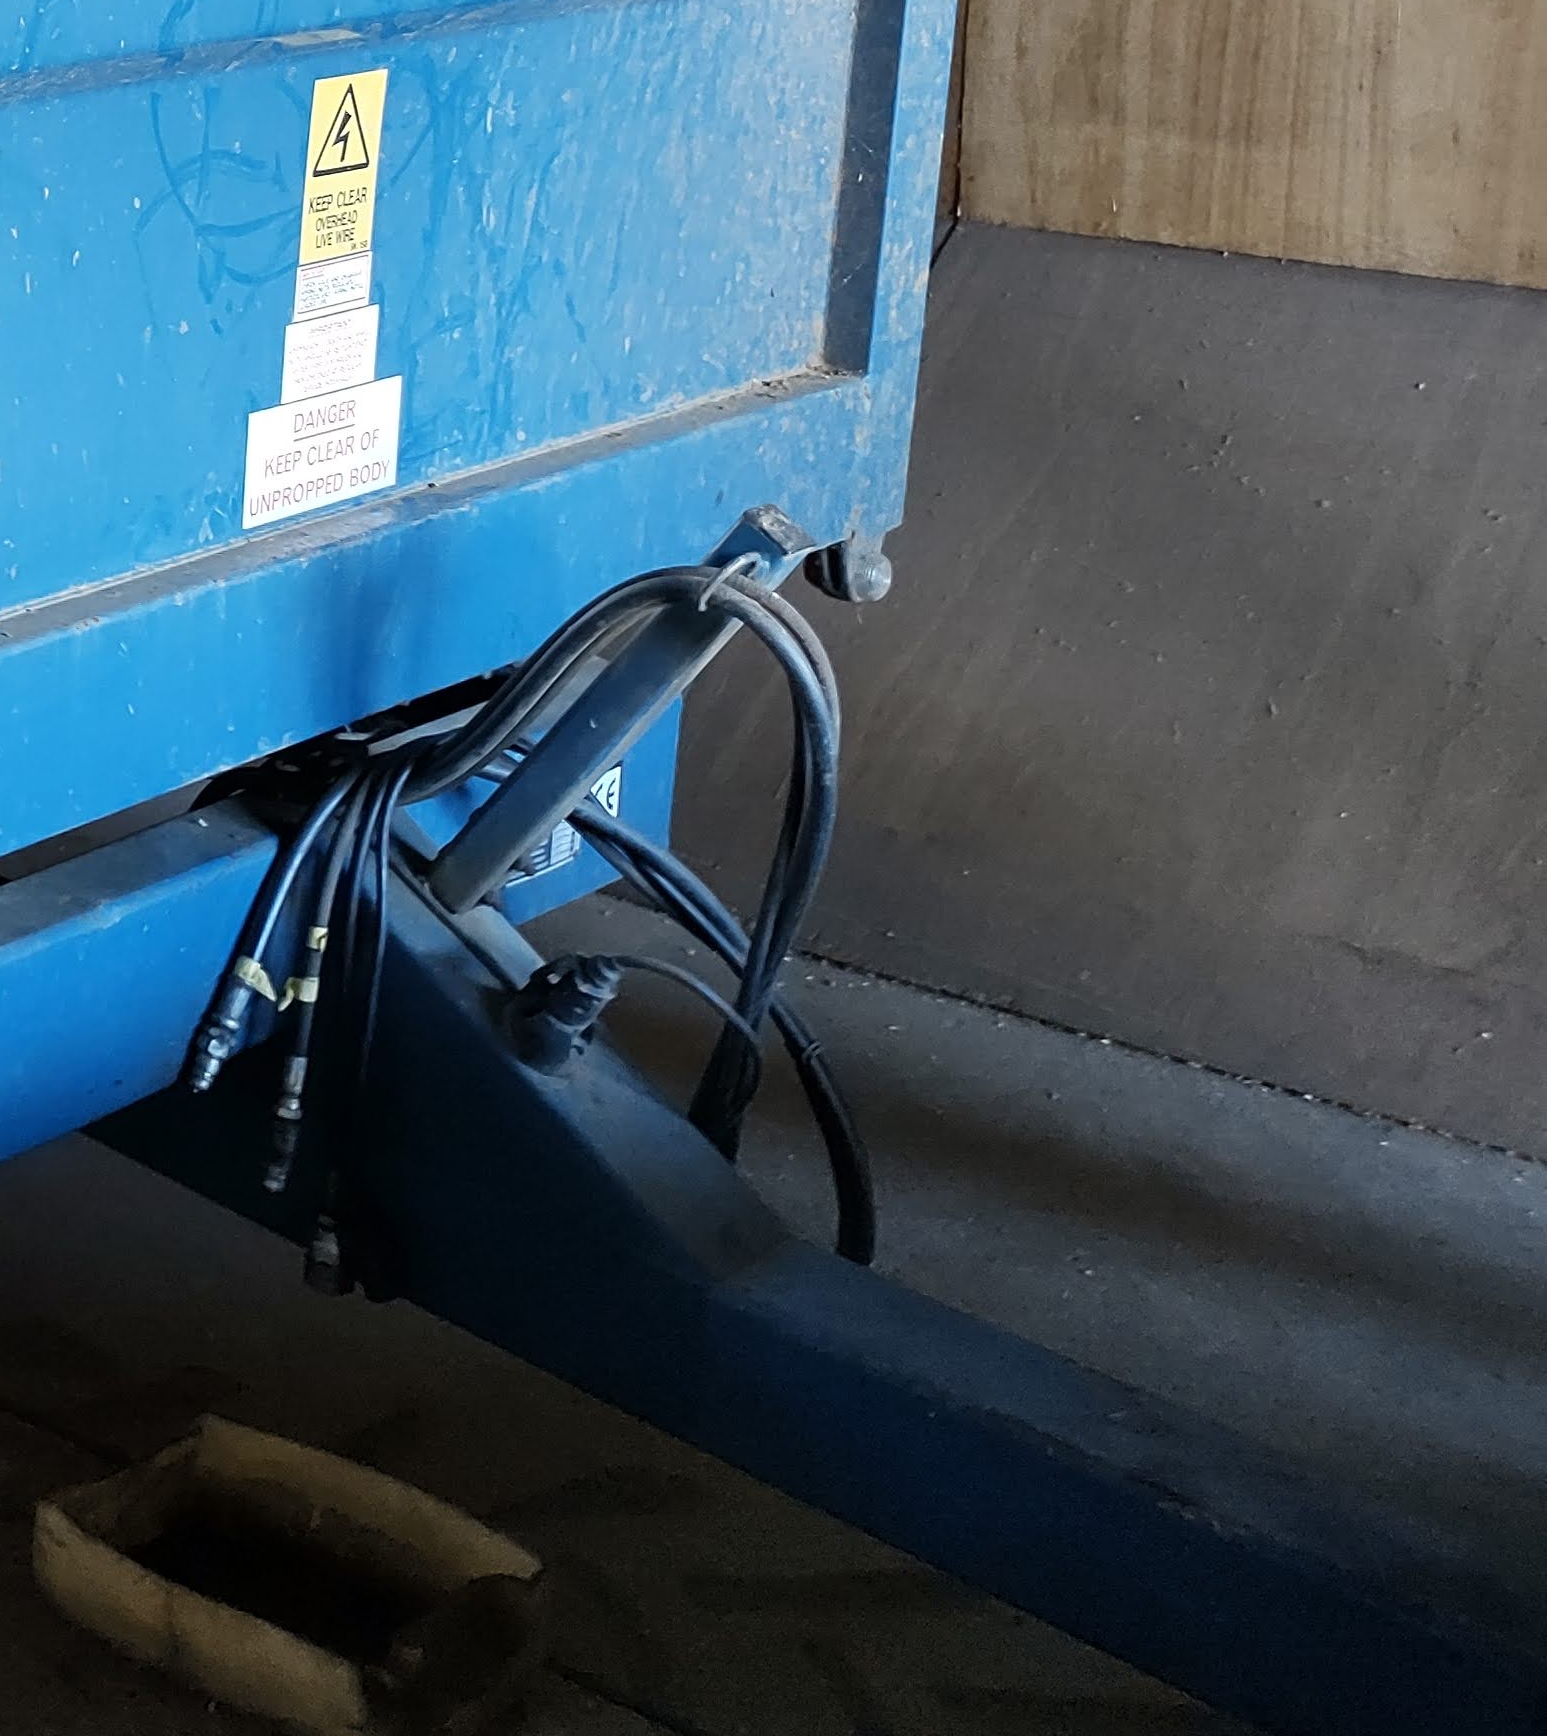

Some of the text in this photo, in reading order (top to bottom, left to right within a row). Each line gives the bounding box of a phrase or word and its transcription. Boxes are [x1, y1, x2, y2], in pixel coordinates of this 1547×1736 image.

[308, 187, 368, 215] KEEP CLEAR
[315, 209, 358, 232] OVERHEAD
[315, 231, 333, 249] LIVE
[335, 227, 355, 244] WIRE
[293, 399, 357, 434] DANGER
[264, 428, 380, 480] KEEP CLEAR OF
[249, 459, 391, 517] UNPROPPED BODY
